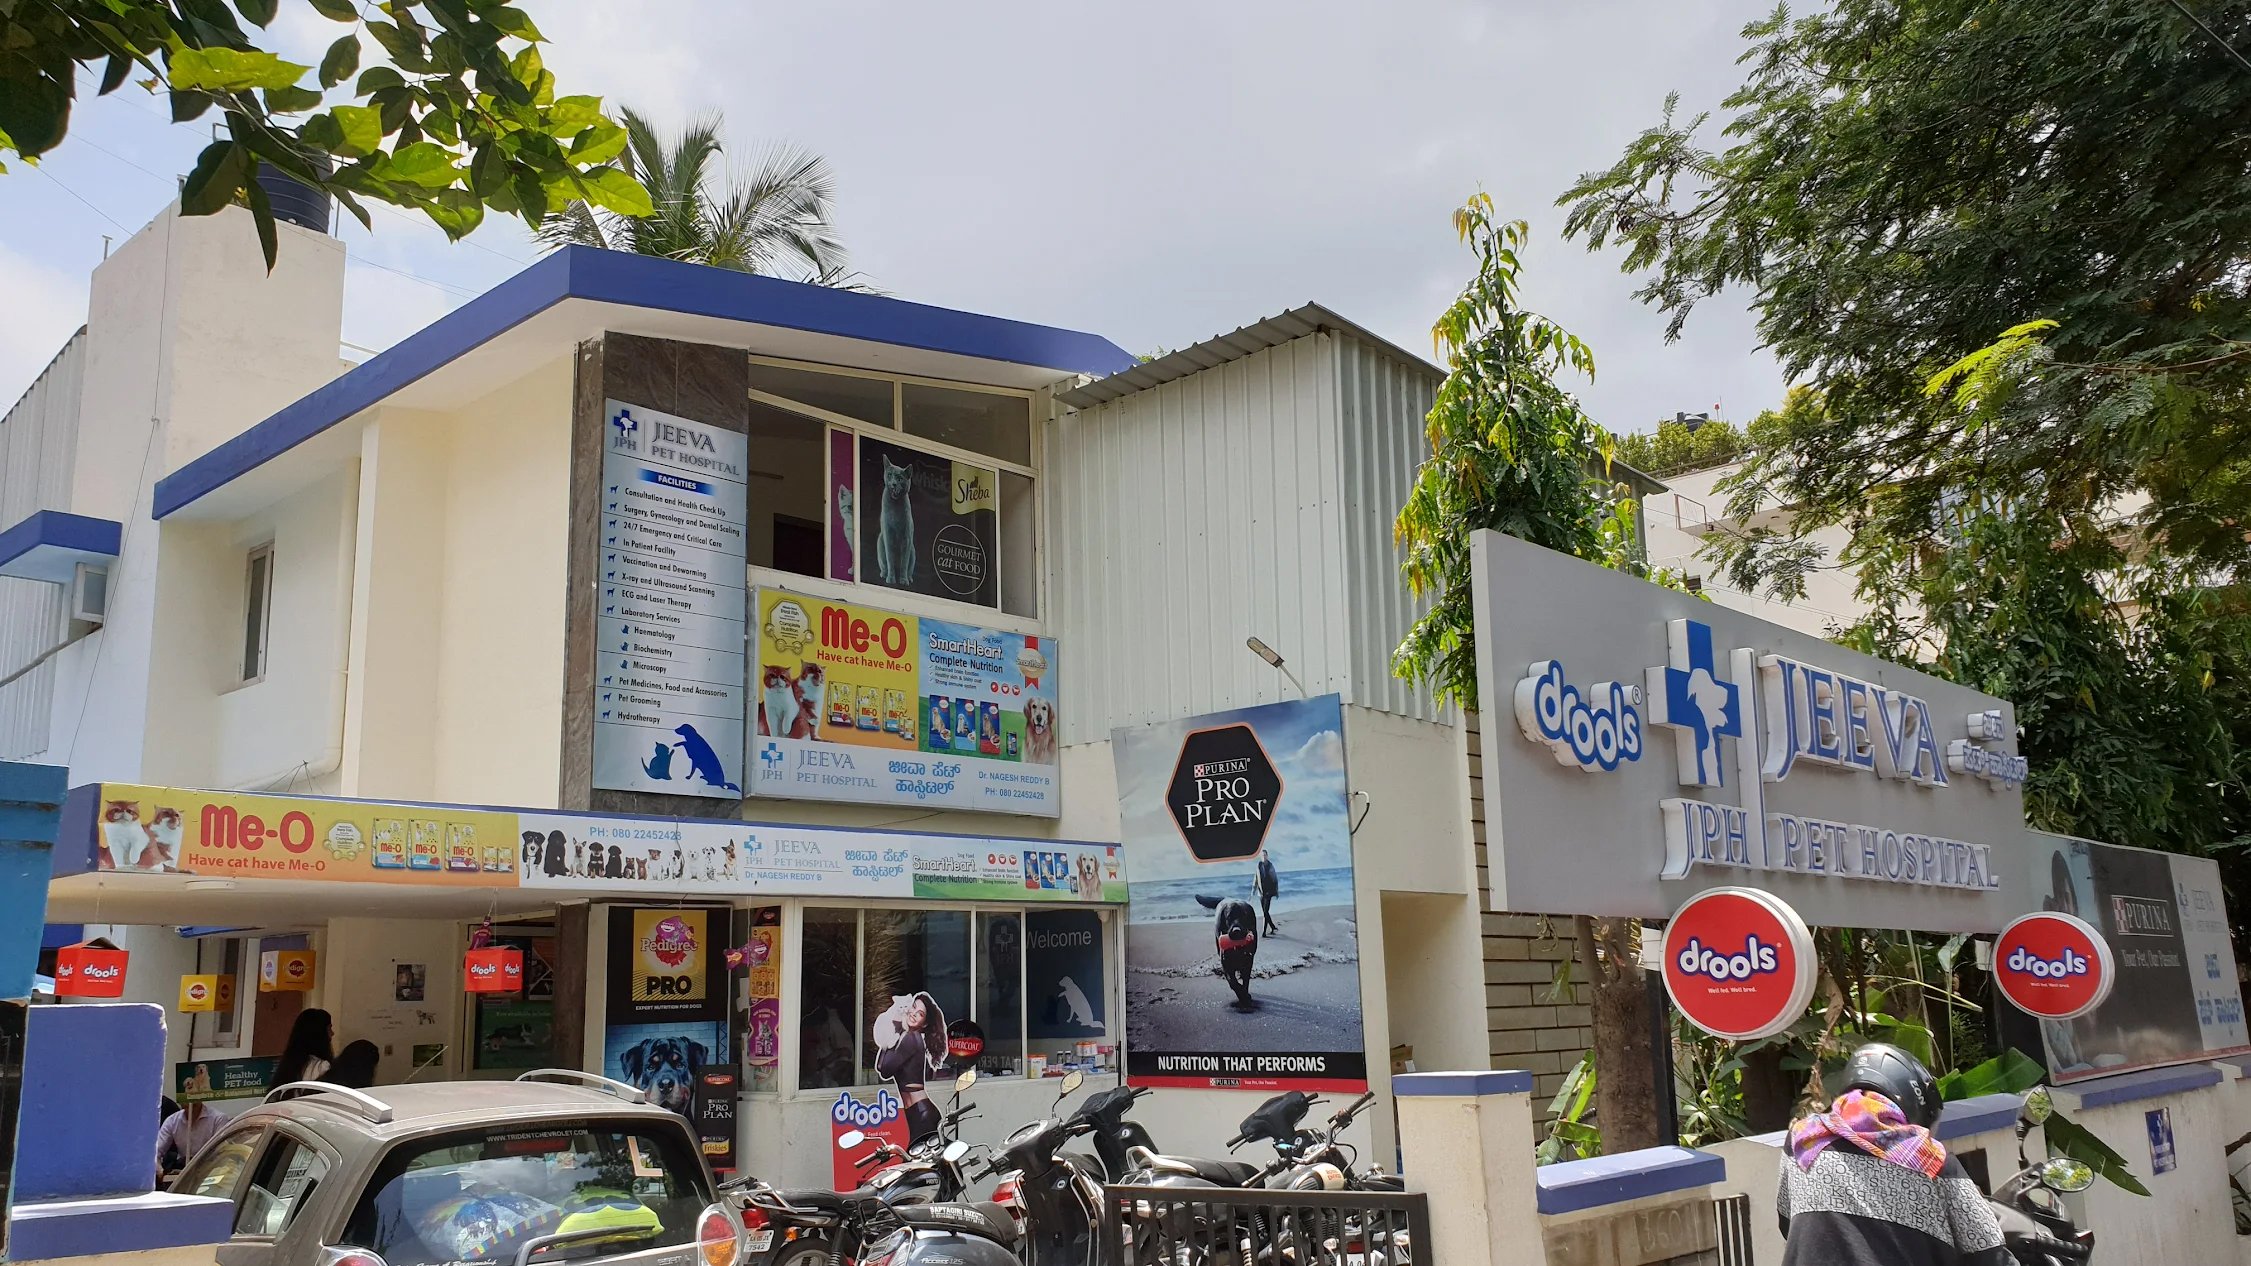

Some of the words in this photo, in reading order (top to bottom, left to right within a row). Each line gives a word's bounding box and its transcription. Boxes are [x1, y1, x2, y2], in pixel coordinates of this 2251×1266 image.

[613, 436, 637, 451] JPH
[652, 421, 716, 453] JEEVA
[652, 445, 676, 460] PET
[679, 451, 740, 477] HOSPITAL
[658, 474, 697, 490] FACILITIES
[954, 478, 990, 504] Sheba
[625, 488, 663, 502] Consultation
[664, 497, 676, 506] and
[677, 499, 698, 511] Health
[699, 503, 716, 515] Check
[717, 507, 726, 517] Up
[624, 505, 648, 518] Surgery,
[650, 509, 685, 525] Gynecology
[686, 516, 698, 526] and
[699, 520, 719, 531] Dental
[720, 524, 740, 537] Scaling
[623, 521, 638, 532] 24/7
[639, 525, 672, 540] Emergency
[673, 531, 685, 541] and
[686, 533, 708, 545] Critical
[709, 538, 723, 548] Care
[623, 539, 630, 547] In
[631, 540, 653, 552] Patient
[654, 544, 676, 557] Facility
[937, 544, 981, 562] GOURMET
[622, 556, 658, 570] Vaccination
[659, 562, 671, 572] and
[672, 564, 707, 579] Deworming
[937, 556, 954, 569] cat
[954, 561, 981, 575] FOOD
[621, 573, 637, 585] X-ray
[638, 576, 652, 585] and
[653, 578, 687, 591] Ultrasound
[688, 583, 716, 597] Scanning
[621, 590, 635, 601] ECG
[636, 592, 648, 601] and
[649, 594, 666, 605] Laser
[667, 597, 692, 610] Therapy
[621, 607, 655, 620] Laboratory
[656, 612, 681, 624] Services
[634, 626, 676, 641] Haematology
[633, 643, 673, 658] Biochemistry
[929, 632, 1003, 660] SmartHeart
[632, 661, 667, 674] Microscopy
[817, 649, 843, 664] Have
[844, 654, 859, 666] cat
[861, 656, 885, 670] have
[886, 661, 912, 673] Me-O
[930, 653, 968, 669] Complete
[970, 659, 1003, 674] Nutrition
[618, 676, 629, 686] Pet
[630, 678, 664, 691] Medicines,
[665, 682, 681, 693] Food
[681, 684, 694, 694] and
[695, 686, 728, 698] Accessories
[618, 693, 629, 703] Pet
[629, 695, 661, 708] Grooming
[617, 711, 661, 725] Hydrotherapy
[1525, 660, 1642, 772] drools
[1760, 654, 1949, 789] JEEVA
[797, 749, 855, 770] JEEVA
[1204, 758, 1247, 776] PURINA
[761, 769, 783, 781] JPH
[796, 772, 819, 783] PET
[822, 774, 878, 788] HOSPITAL
[989, 772, 1019, 783] NAGESH
[1020, 775, 1044, 785] REDDY
[985, 787, 998, 797] PH:
[999, 788, 1012, 798] 080
[1013, 789, 1045, 800] 22452428
[1195, 777, 1250, 804] PRO
[1184, 800, 1265, 829] PLAN
[588, 826, 609, 838] PH:
[612, 828, 631, 839] 080
[634, 829, 682, 841] 22452428
[1663, 798, 1751, 881] JPH
[773, 839, 822, 856] JEEVA
[1777, 815, 1848, 875] PET
[1855, 825, 2000, 892] HOSPITAL
[188, 853, 224, 868] Have
[227, 855, 249, 869] cat
[251, 856, 286, 870] have
[288, 859, 326, 872] Me-O
[774, 857, 792, 866] PET
[794, 858, 841, 869] HOSPITAL
[912, 855, 977, 873] SmartHeart
[756, 872, 789, 880] NAGESH
[790, 873, 815, 881] REDDY
[914, 873, 947, 884] Complete
[948, 874, 978, 884] Nutrition
[2127, 902, 2172, 932] PURINA
[640, 937, 699, 954] Pedigree
[1026, 930, 1092, 949] Welcome
[1680, 936, 1776, 979] drools
[2009, 947, 2087, 978] drools
[84, 963, 119, 978] drools
[471, 963, 496, 975] drools
[646, 975, 692, 996] PRO
[949, 1040, 980, 1052] SUPERCOAT
[1158, 1055, 1219, 1072] NUTRITION
[1223, 1056, 1254, 1072] THAT
[1256, 1056, 1326, 1072] PERFORMS
[224, 1071, 258, 1080] Healthy
[224, 1080, 242, 1088] PET
[243, 1078, 262, 1087] food
[1910, 1079, 1927, 1106] EON
[703, 1110, 733, 1119] PLAN
[708, 1103, 729, 1112] PRO
[834, 1091, 897, 1126] drools
[486, 1129, 589, 1142] WWW.TRIDENTCHEVROLET.COM
[627, 1135, 663, 1177] L
[704, 1142, 728, 1152] Friskies
[921, 1257, 949, 1265] Access
